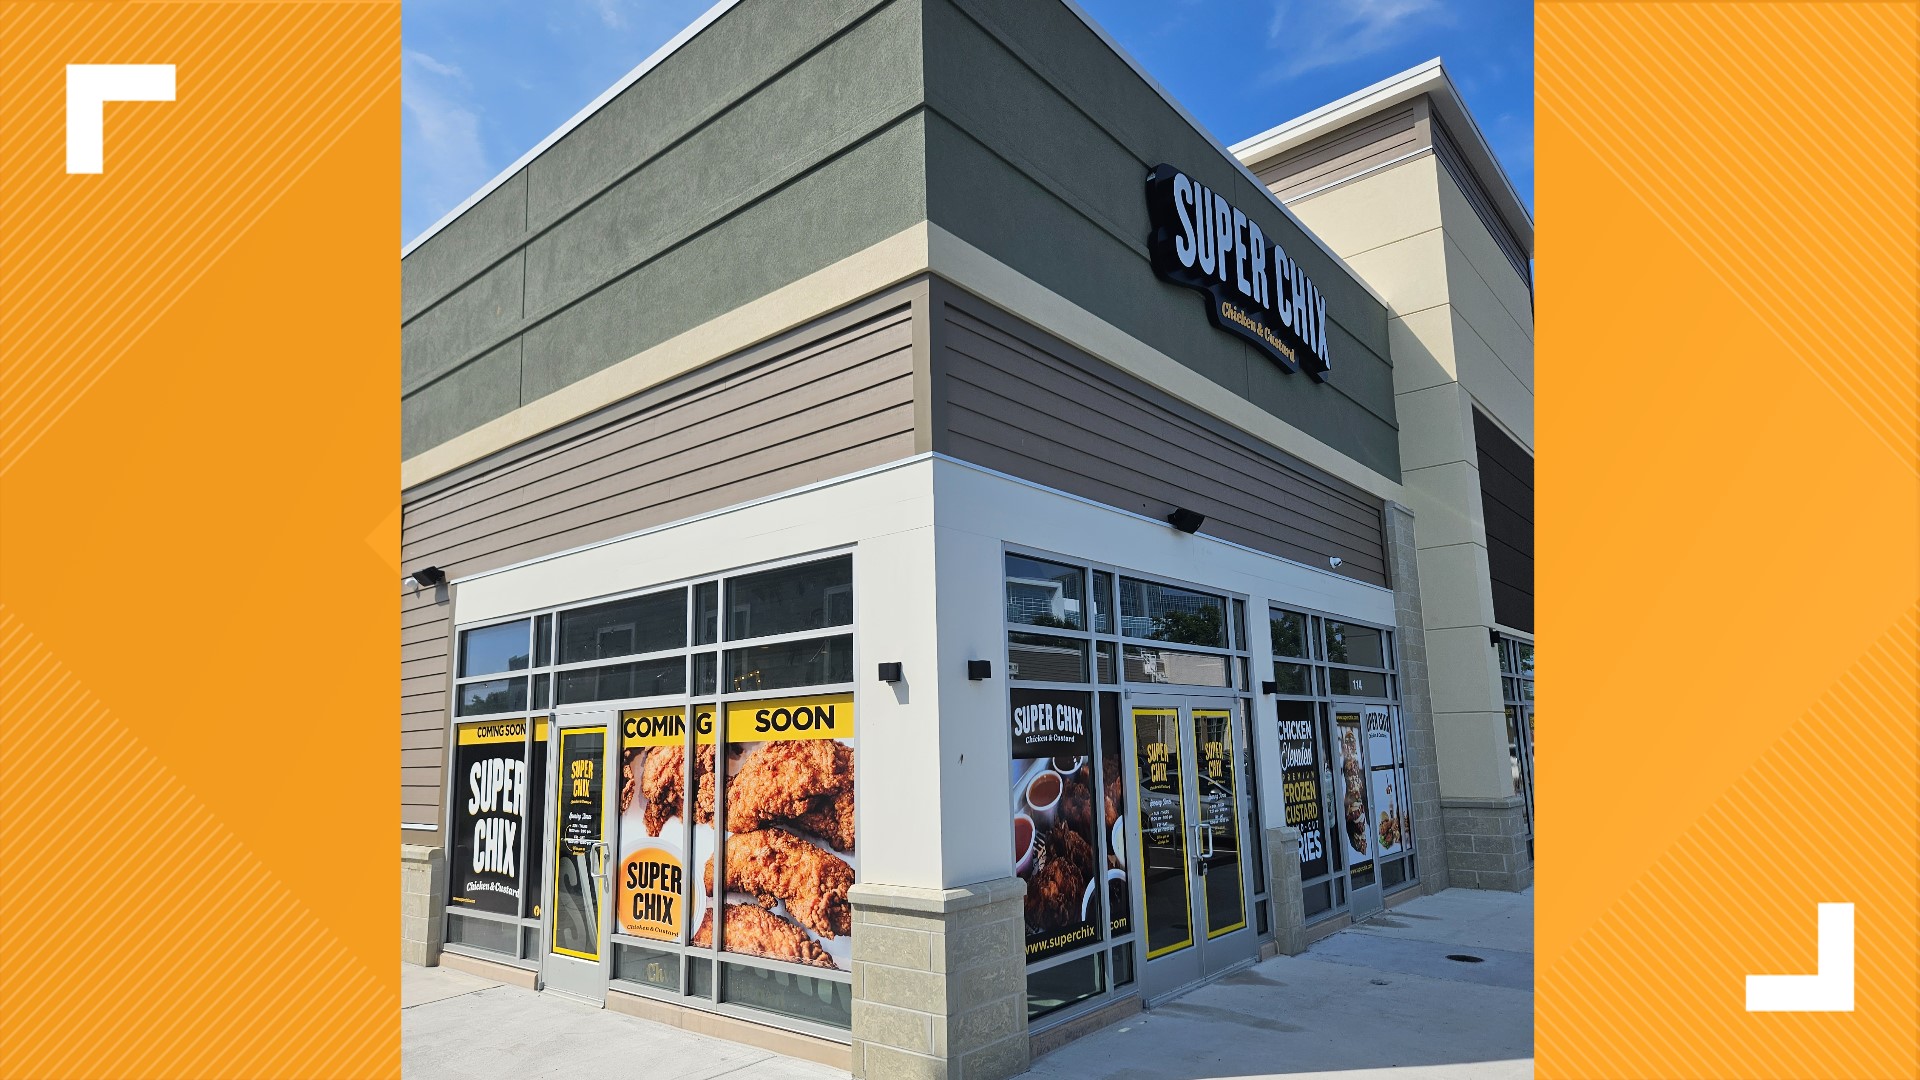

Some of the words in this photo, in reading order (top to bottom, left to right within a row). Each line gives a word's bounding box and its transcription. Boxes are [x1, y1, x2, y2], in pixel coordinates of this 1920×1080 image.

[1174, 173, 1269, 309] SUPER
[1274, 244, 1331, 370] CHIX
[1221, 301, 1256, 333] Chicken
[1256, 322, 1264, 338] &
[1264, 327, 1296, 363] Custard
[1352, 679, 1363, 691] 114
[754, 704, 835, 732] SOON
[1014, 703, 1053, 736] SUPER
[1056, 703, 1084, 736] CHIX
[477, 724, 505, 738] COMING
[505, 723, 526, 736] SOON
[1025, 734, 1048, 744] Chicken
[1054, 733, 1075, 743] Custard
[1277, 720, 1312, 740] CHICKEN
[1147, 742, 1169, 763] SUPER
[1204, 741, 1223, 761] SUPER
[571, 759, 593, 779] SUPER
[1151, 762, 1168, 783] CHIX
[468, 758, 525, 818] SUPER
[573, 778, 590, 798] CHIX
[1284, 780, 1317, 804] FROZEN
[1286, 801, 1318, 823] CUSTARD
[473, 817, 516, 878] CHIX
[626, 861, 682, 895] SUPER
[466, 881, 490, 892] Chicken
[489, 882, 495, 891] &
[494, 882, 520, 899] Custard
[632, 892, 674, 925] CHIX
[626, 924, 650, 932] Chicken
[654, 926, 679, 937] Custard
